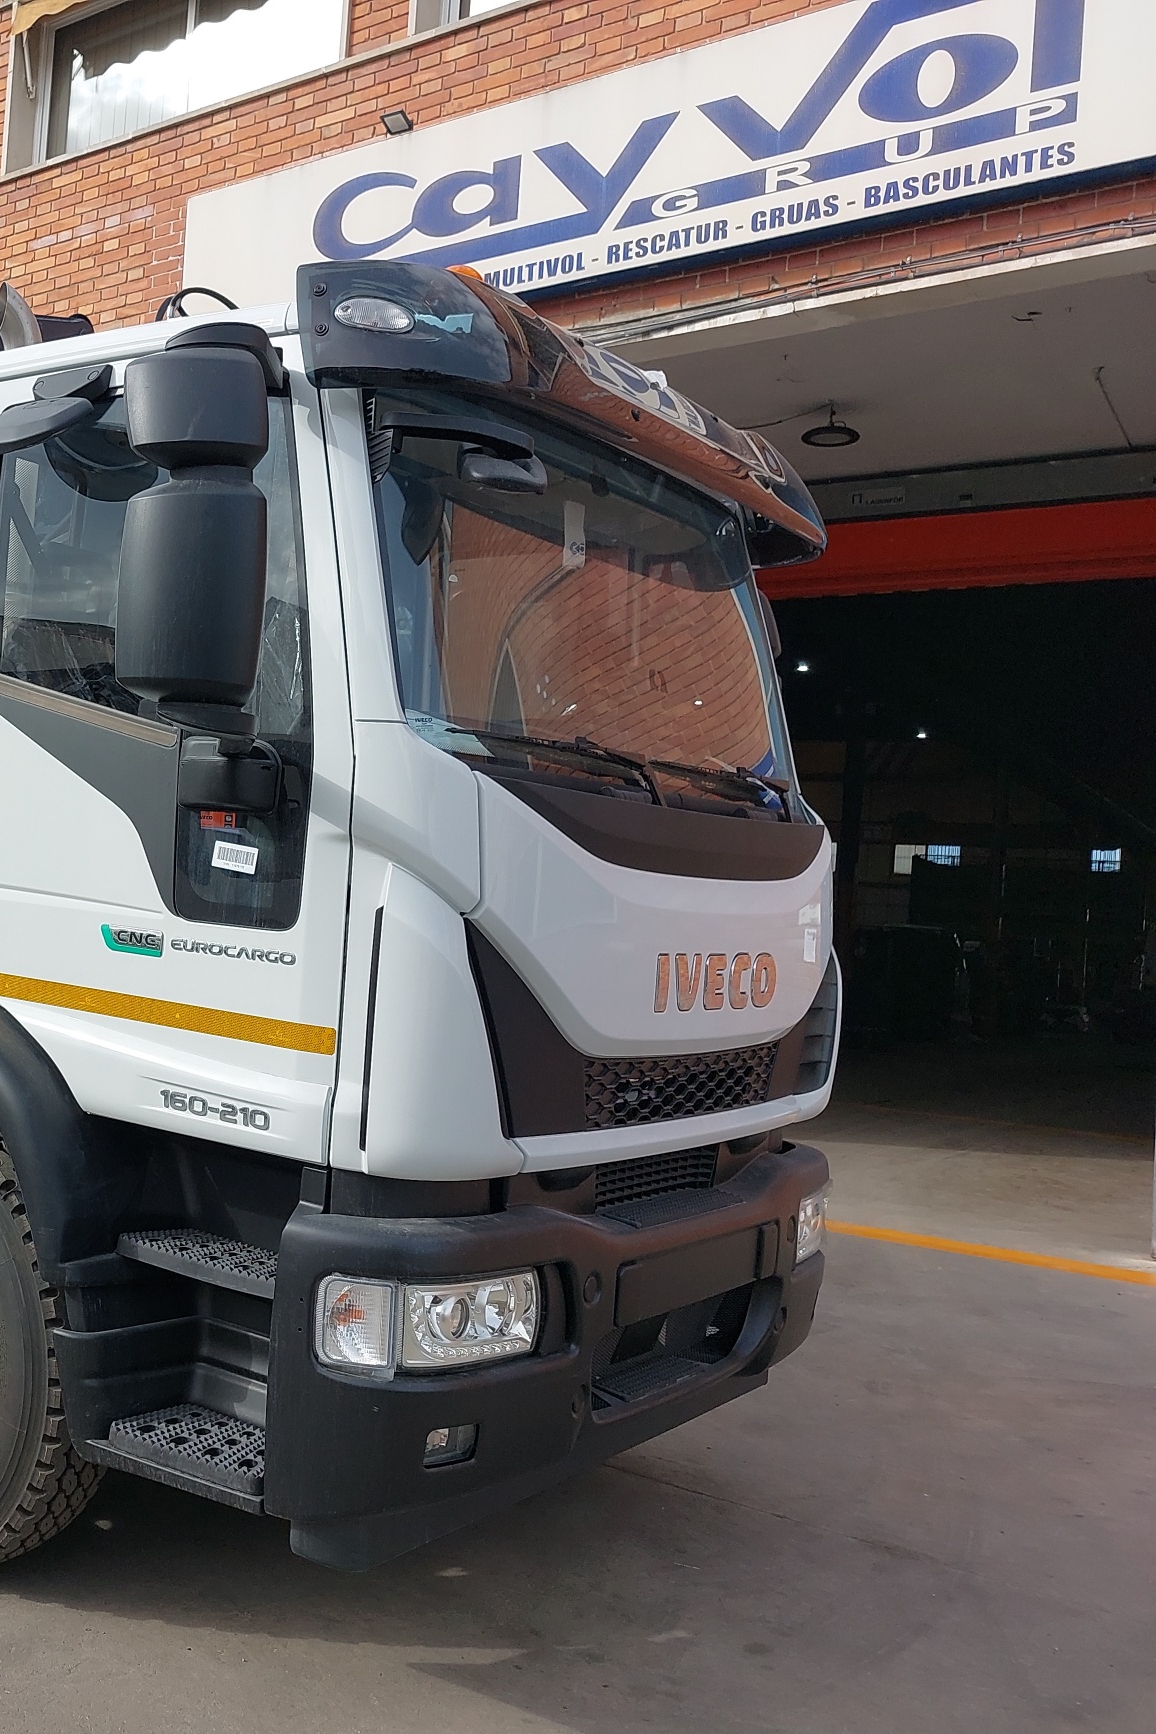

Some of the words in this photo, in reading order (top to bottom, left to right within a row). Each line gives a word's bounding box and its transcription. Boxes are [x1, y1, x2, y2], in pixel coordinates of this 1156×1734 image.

[484, 252, 585, 290] MULTIVOL
[607, 219, 728, 265] RESCATUR
[750, 194, 839, 234] GRUAS
[864, 141, 1076, 210] BASCULANTES
[117, 930, 158, 948] CNG
[170, 938, 297, 966] EUROCARGO
[653, 952, 777, 1014] IVECO
[159, 1089, 271, 1131] 160-210
